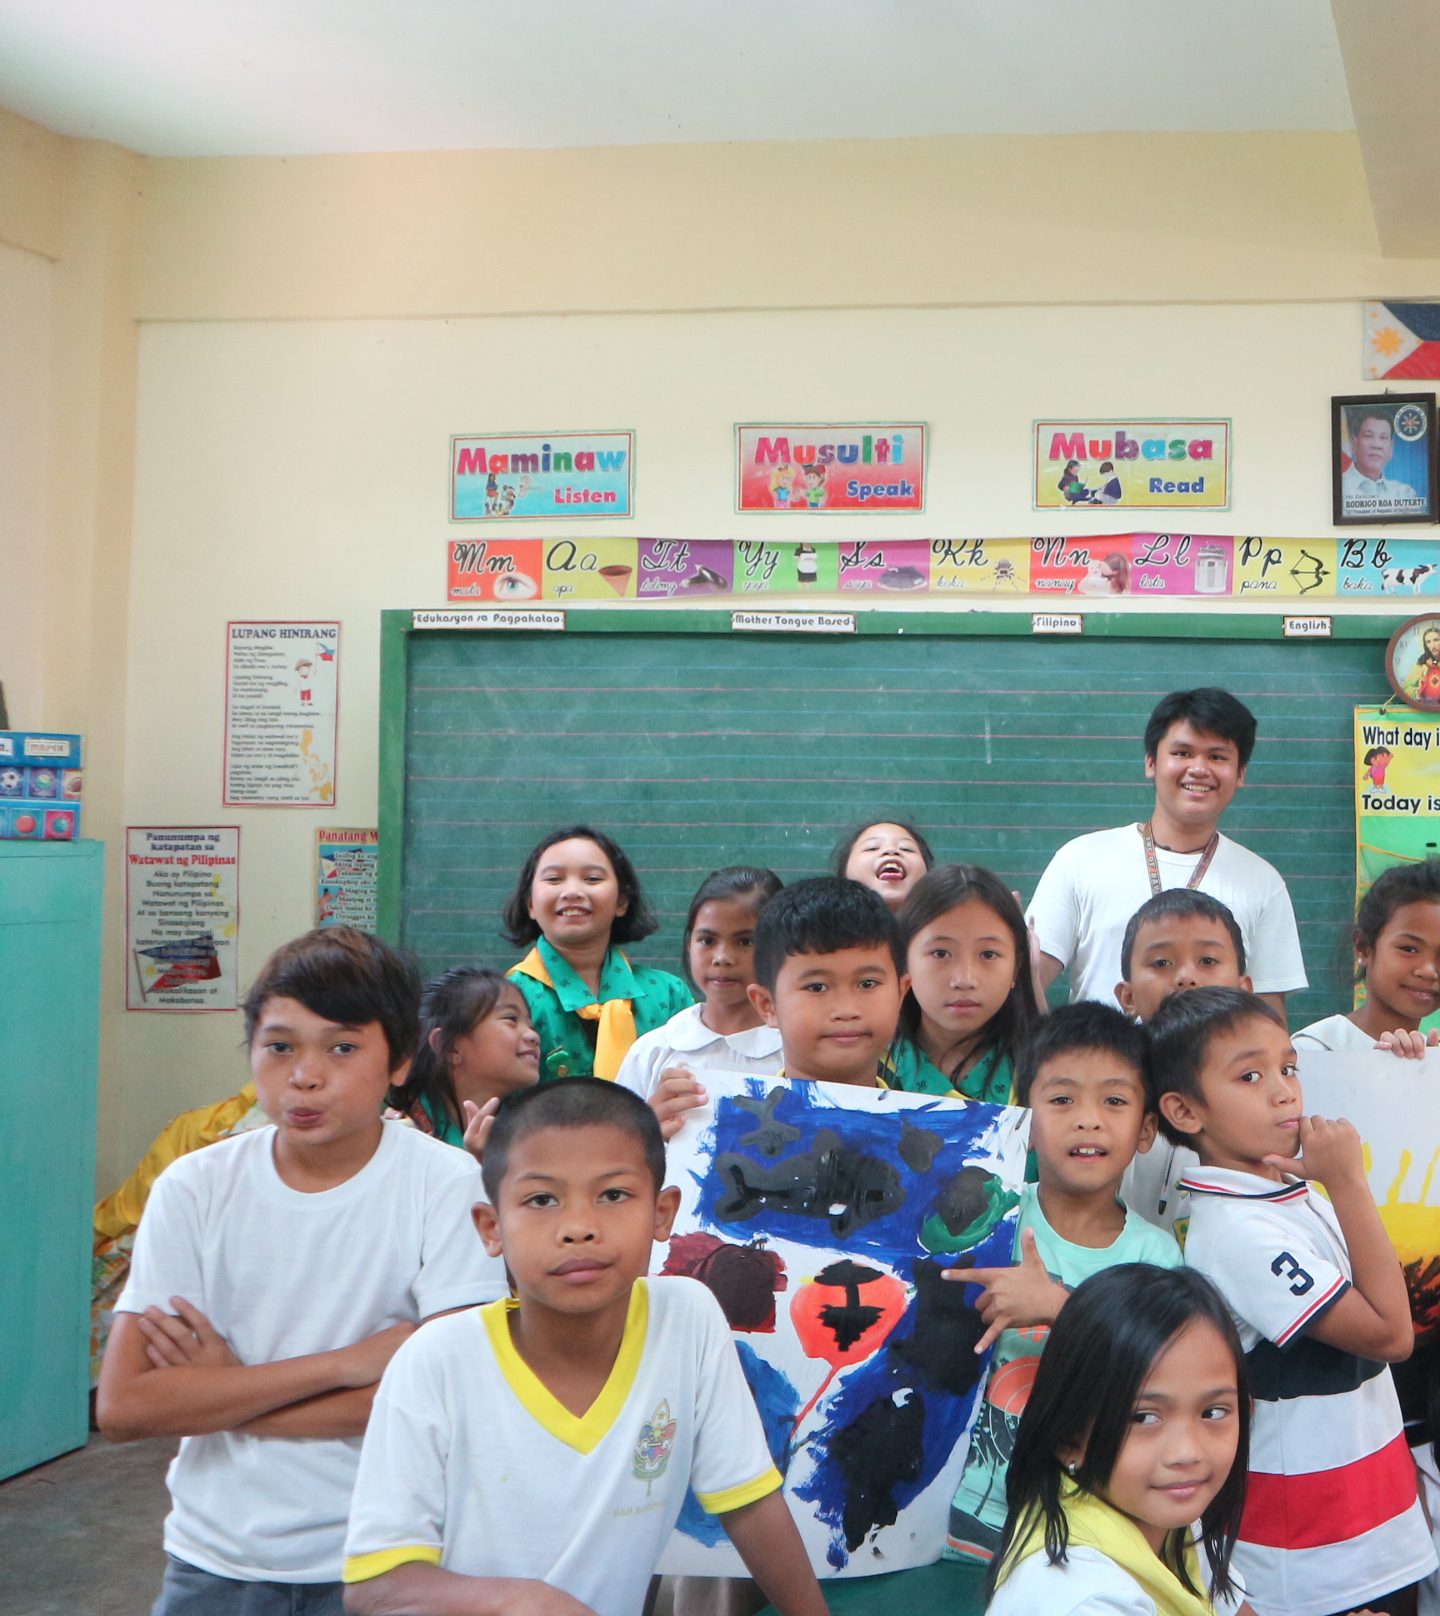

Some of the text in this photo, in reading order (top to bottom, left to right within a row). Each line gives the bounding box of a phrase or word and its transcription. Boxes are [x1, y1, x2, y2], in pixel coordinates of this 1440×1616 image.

[754, 434, 905, 466] Musulti
[1049, 432, 1213, 461] Mubasa
[457, 444, 626, 475] Maminaw
[847, 480, 913, 500] Speak
[1149, 476, 1204, 494] Read
[554, 487, 616, 504] Listen
[1345, 500, 1377, 508] RODRIGO
[1395, 499, 1425, 507] DUTERTE
[1241, 580, 1278, 593] pana
[417, 613, 560, 627] Edukasyon sa Pagpakatao
[736, 614, 850, 628] Mother Tongue Based
[1036, 617, 1077, 629] Filipino
[1289, 620, 1327, 632] English
[231, 628, 337, 639] LUPANG HINIRANG
[1363, 726, 1399, 745] What
[1404, 727, 1431, 750] day
[1362, 795, 1421, 814] Today
[146, 833, 220, 842] Panunumpa ng
[319, 831, 367, 843] Panatang
[151, 843, 202, 852] katapatan
[128, 854, 236, 867] Watawat ng Pilipinas
[1271, 1252, 1314, 1296] 3
